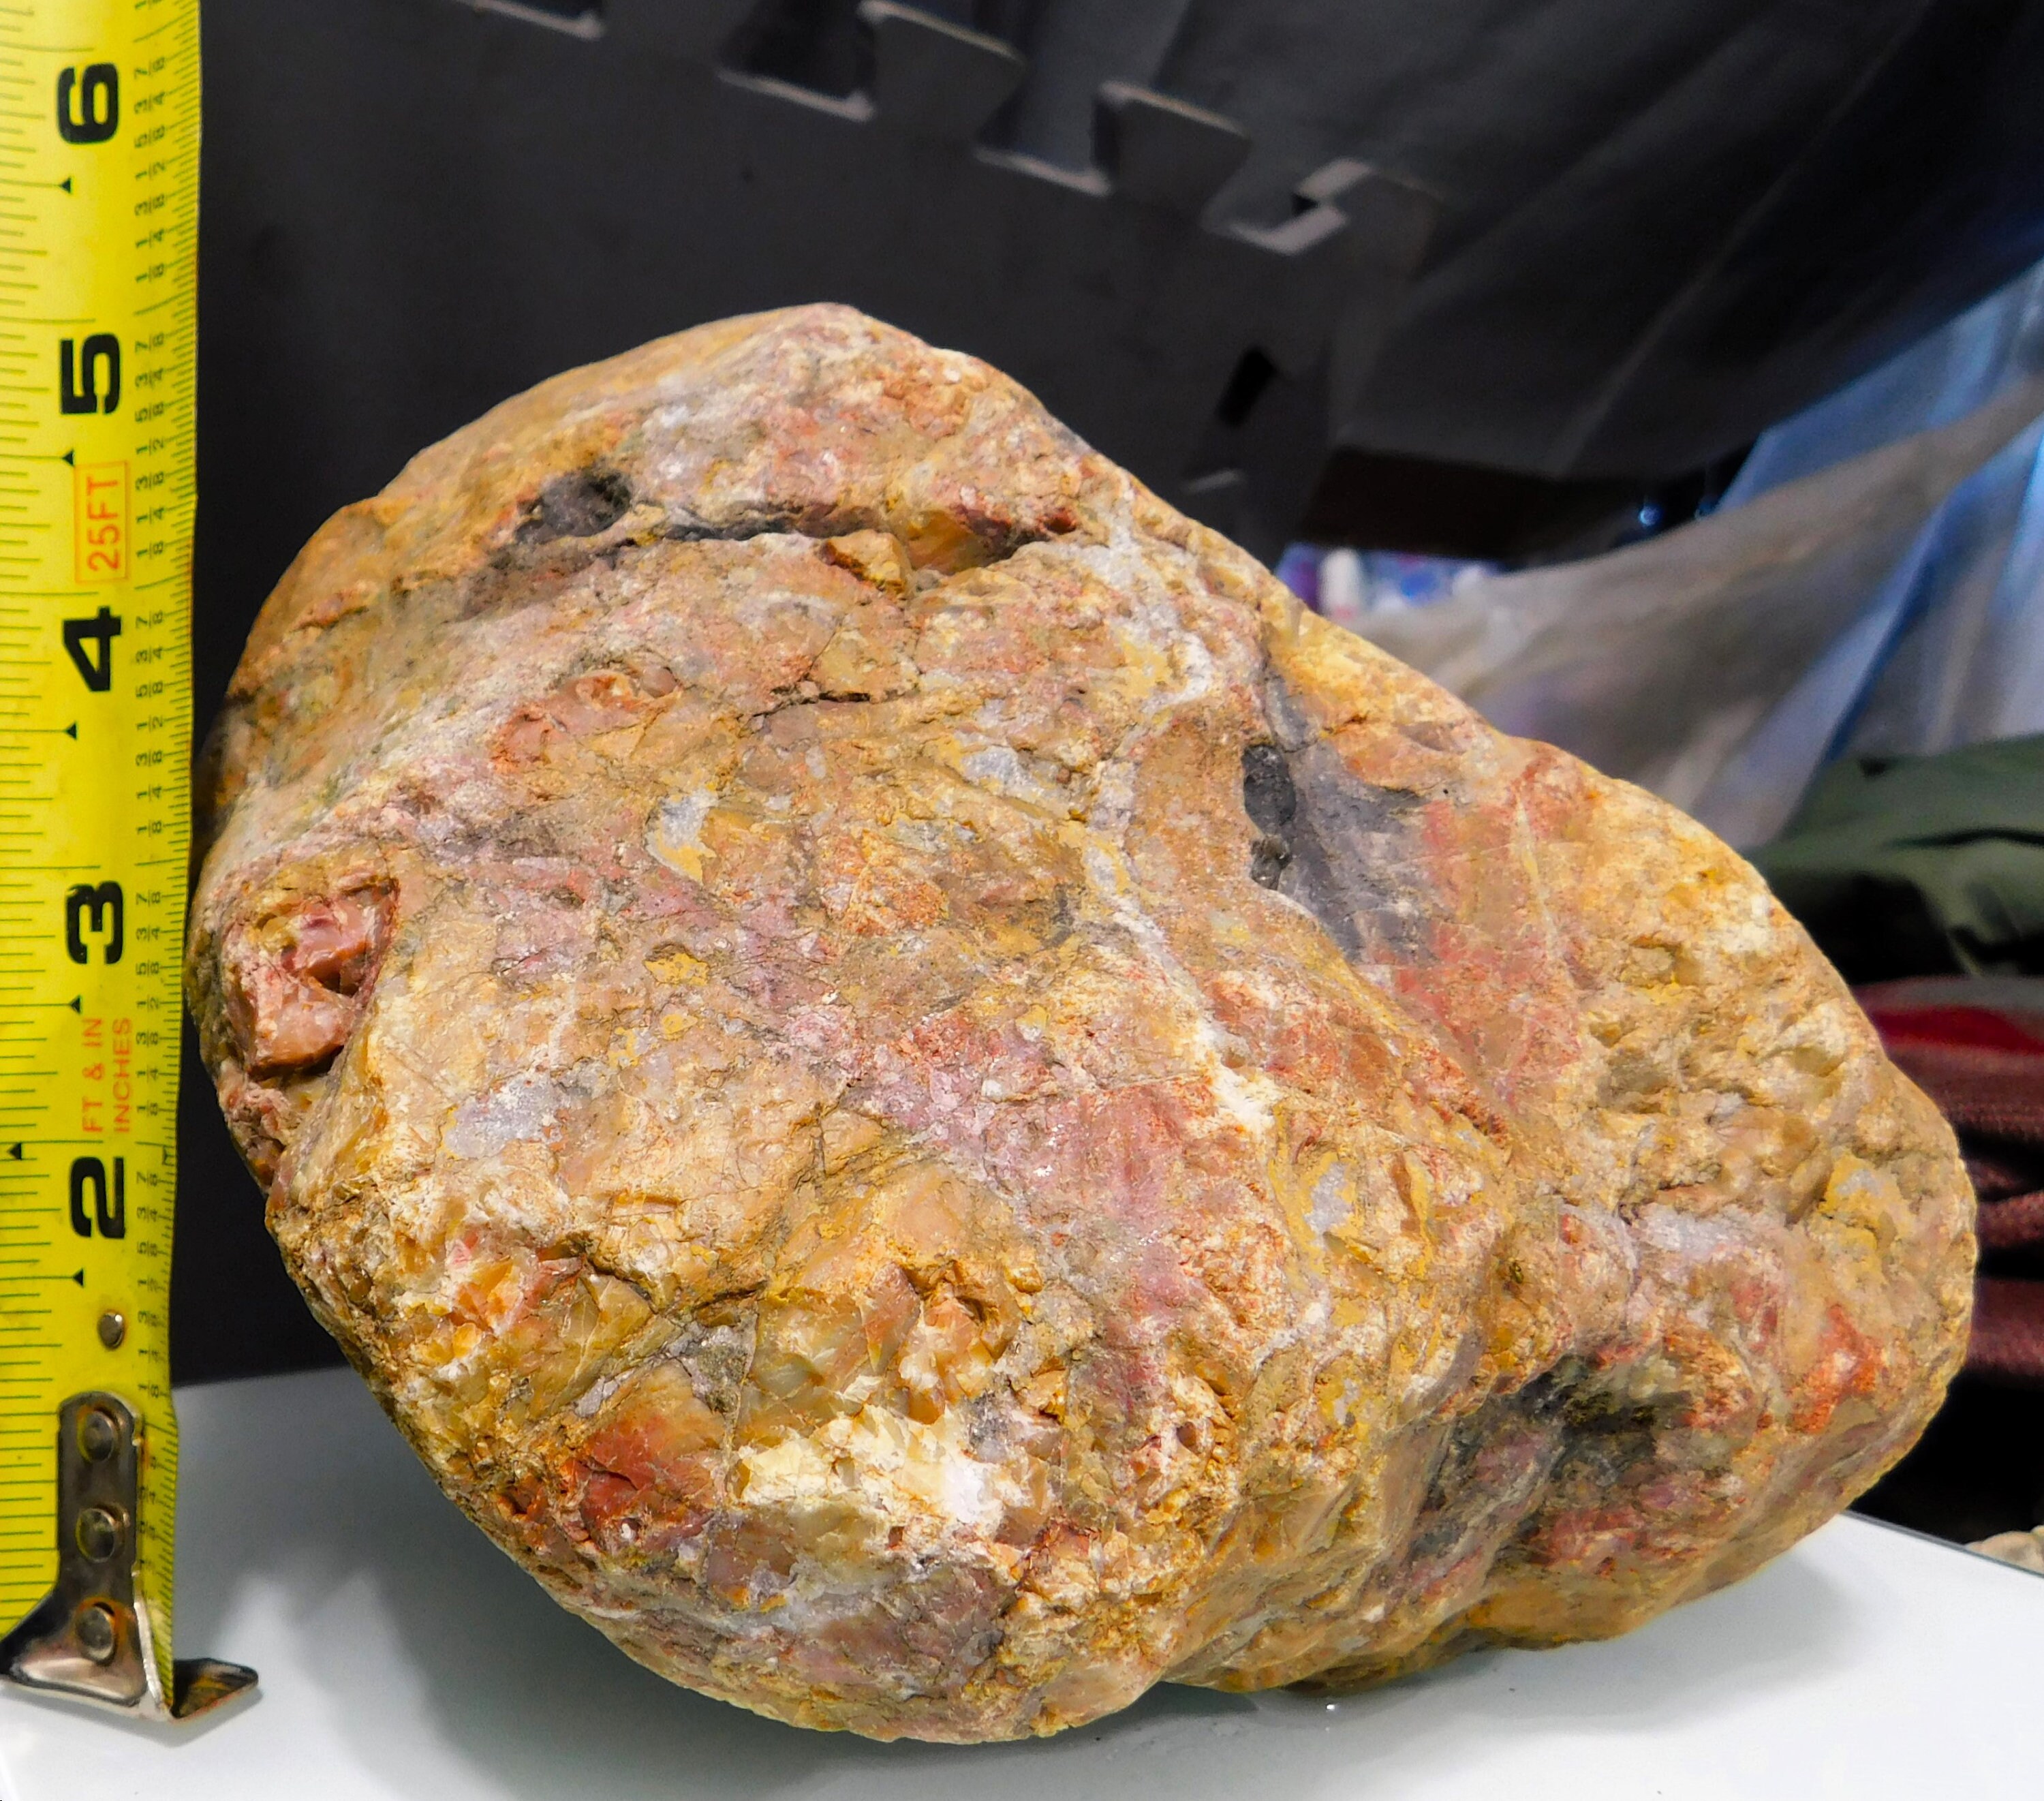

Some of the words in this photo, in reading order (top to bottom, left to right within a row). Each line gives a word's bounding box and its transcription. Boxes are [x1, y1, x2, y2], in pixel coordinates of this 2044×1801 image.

[57, 63, 119, 144] 6
[61, 333, 121, 415] 5
[87, 476, 121, 572] 25FT
[63, 605, 121, 692] 4
[65, 880, 123, 965] 3
[82, 1018, 104, 1048] IN
[82, 1062, 104, 1081] &
[82, 1096, 104, 1133] FT
[112, 1017, 132, 1133] INCHES
[69, 1156, 125, 1239] 2
